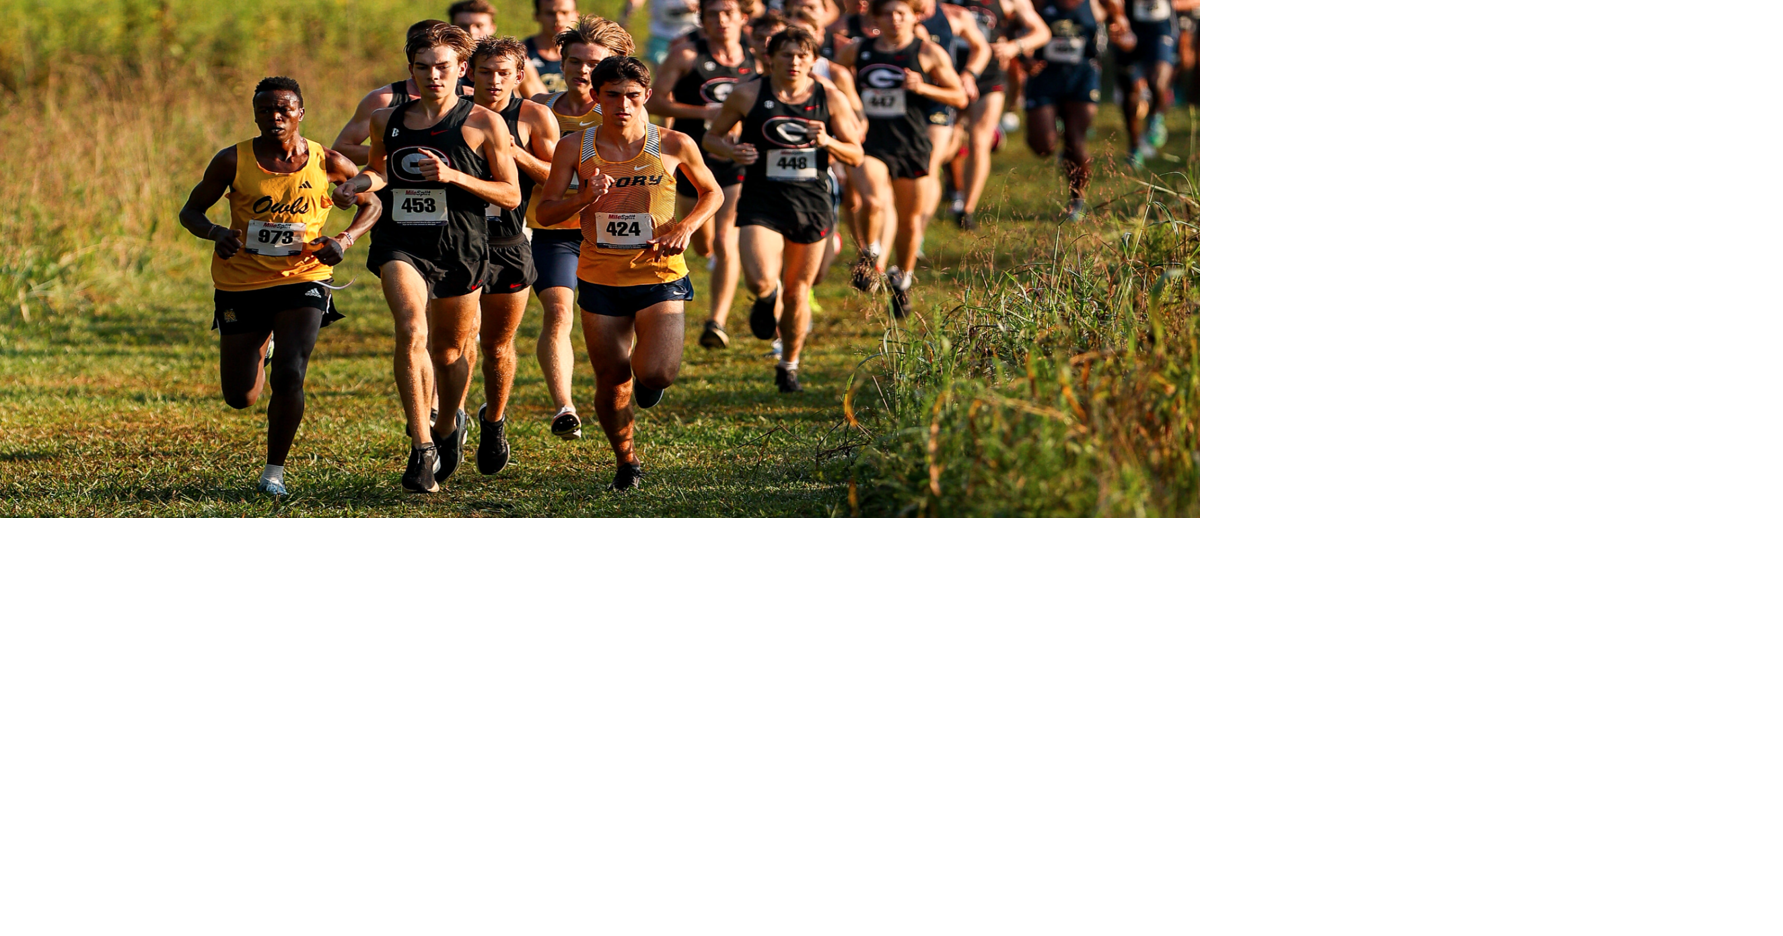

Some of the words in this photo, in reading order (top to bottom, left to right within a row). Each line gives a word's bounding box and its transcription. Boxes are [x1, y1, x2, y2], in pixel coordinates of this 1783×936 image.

[777, 156, 807, 170] 448
[584, 175, 663, 189] ORY
[253, 196, 309, 215] Owls
[401, 197, 436, 213] 453
[258, 229, 294, 245] 973
[606, 221, 641, 237] 424
